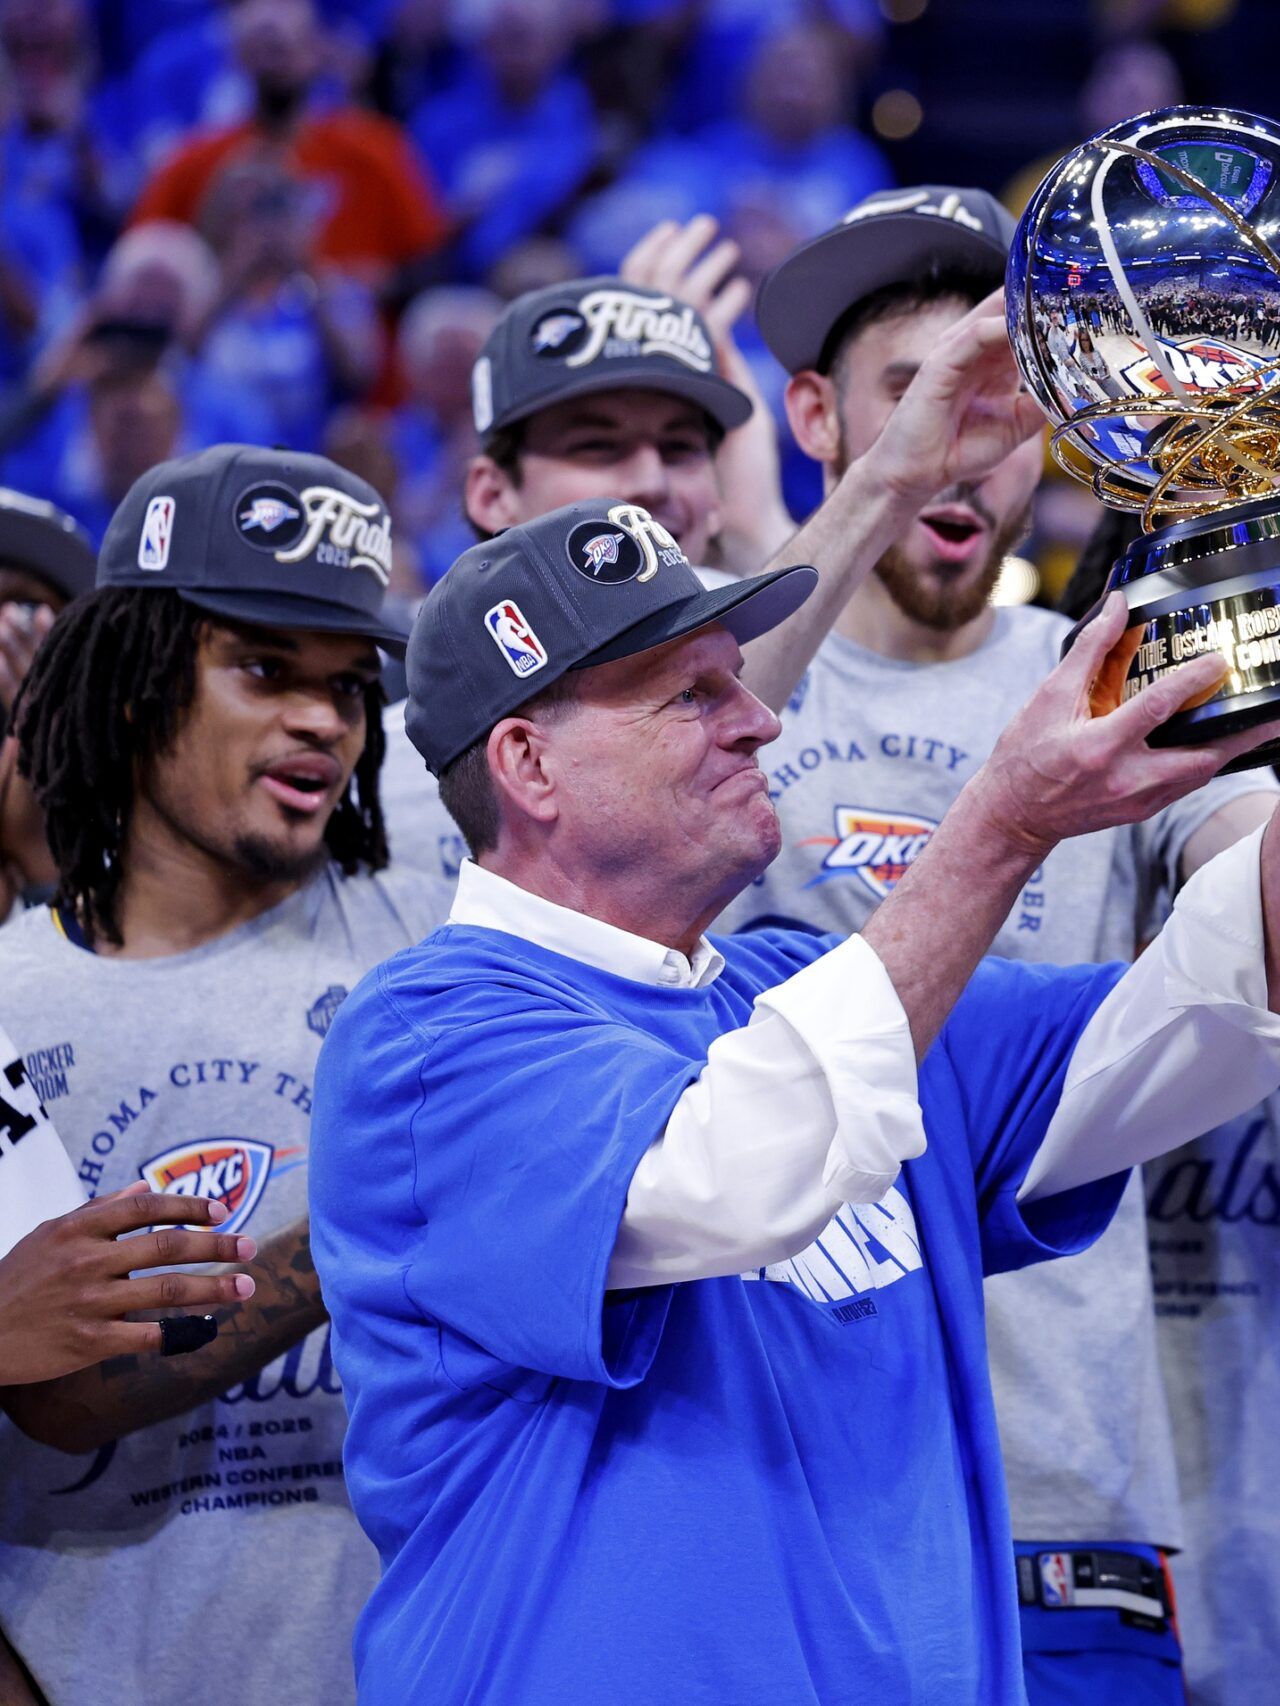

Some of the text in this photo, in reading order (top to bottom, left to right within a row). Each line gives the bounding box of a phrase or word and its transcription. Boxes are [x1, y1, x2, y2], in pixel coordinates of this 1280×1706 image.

[565, 290, 712, 372] Finals
[1137, 637, 1168, 672] THE
[1171, 618, 1236, 662] OSCAR
[515, 653, 537, 673] NBA
[880, 734, 970, 771] CITY
[27, 1043, 75, 1079] OCKER
[169, 1059, 261, 1088] CITY
[178, 1423, 230, 1448] 2024
[249, 1416, 314, 1437] 2025
[218, 1445, 267, 1463] NBA
[130, 1461, 344, 1507] WESTERN CONFERE
[180, 1487, 319, 1515] CHAMPIONS
